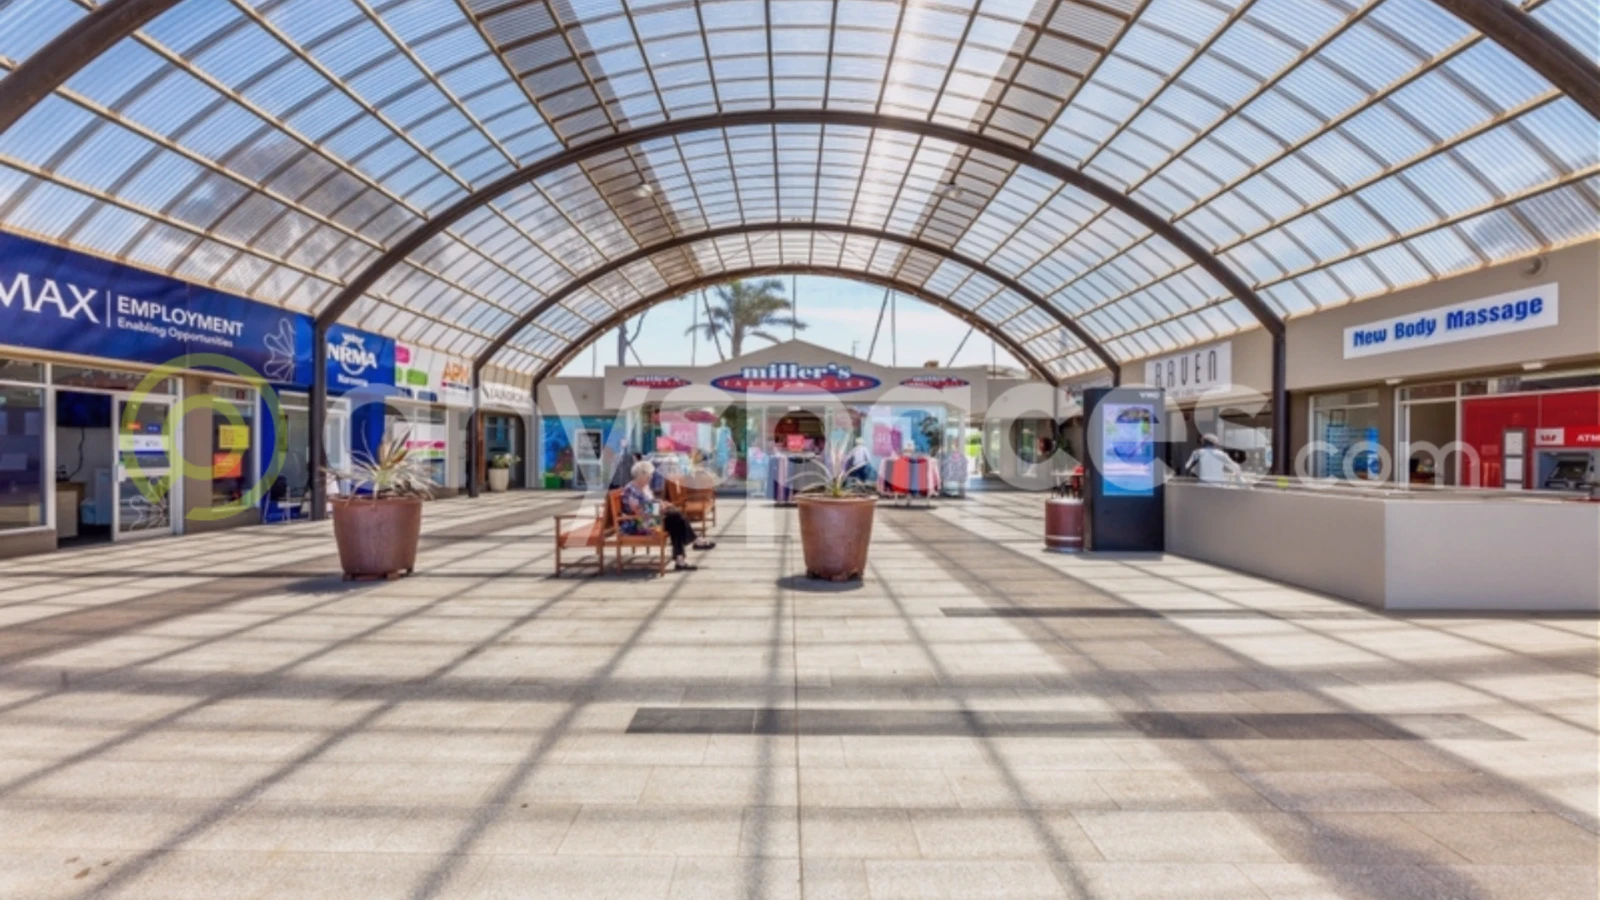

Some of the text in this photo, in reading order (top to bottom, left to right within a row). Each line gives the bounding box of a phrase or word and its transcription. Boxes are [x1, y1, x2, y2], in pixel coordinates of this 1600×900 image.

[117, 295, 244, 337] EMPLOYMENT
[1353, 297, 1544, 347] New Body Massage
[117, 317, 233, 348] Enabling Opportunities
[327, 342, 377, 369] NRMA
[742, 362, 852, 380] miller's
